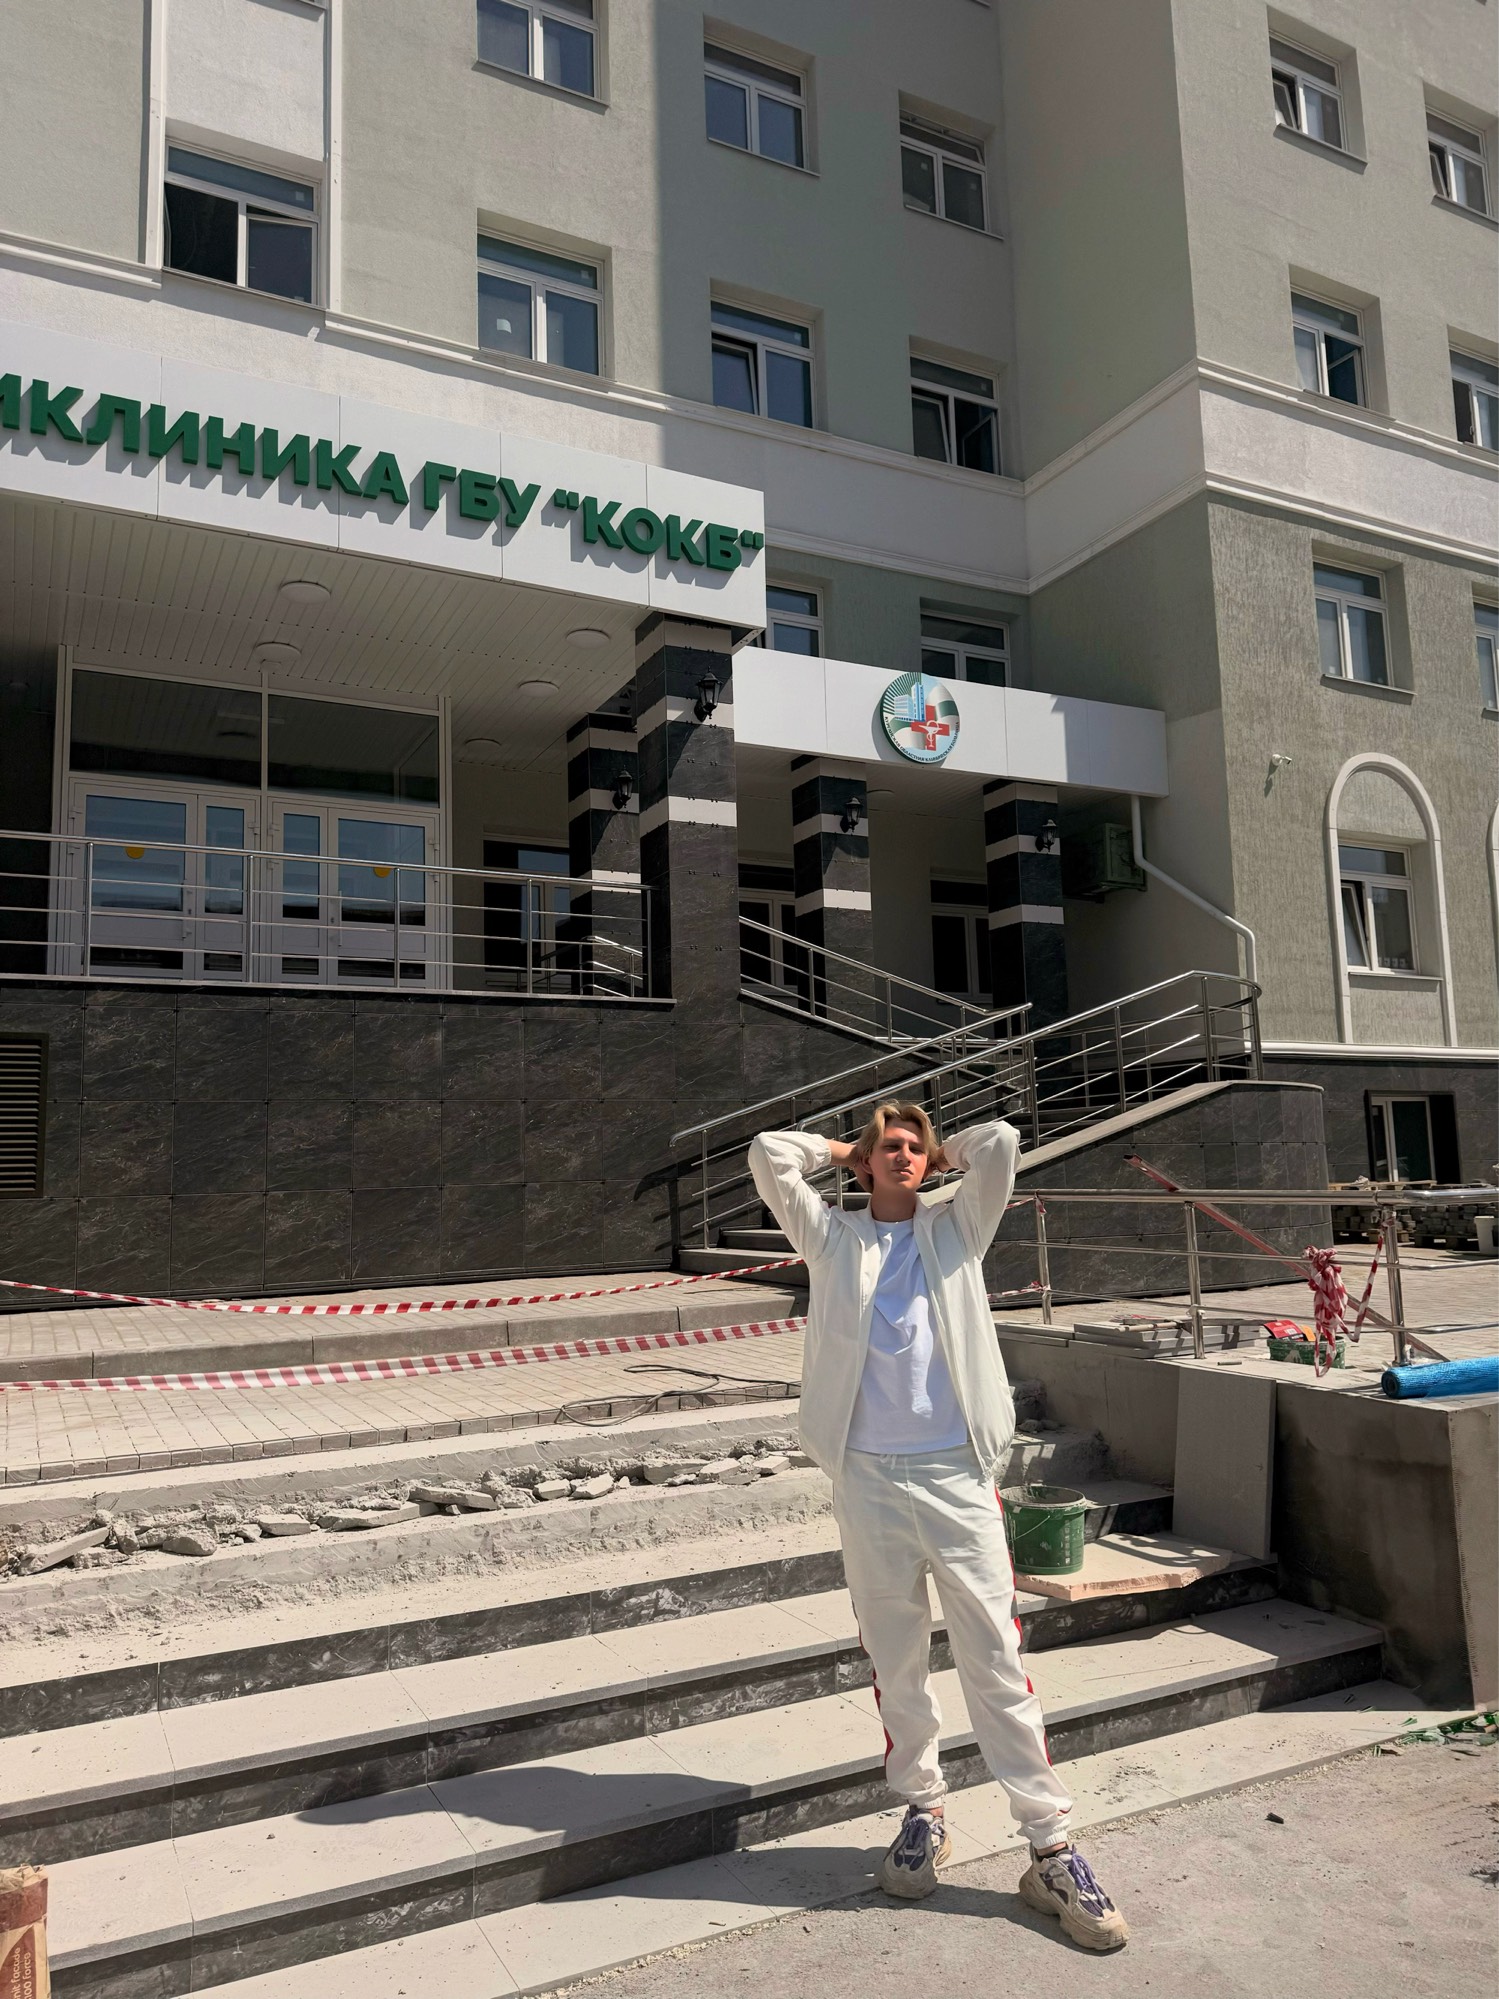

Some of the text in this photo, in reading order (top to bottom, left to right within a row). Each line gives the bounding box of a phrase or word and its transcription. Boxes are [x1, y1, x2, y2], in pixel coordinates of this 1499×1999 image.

[423, 461, 542, 528] ГБУ
[22, 1951, 32, 1980] force
[10, 1984, 21, 1999] nit
